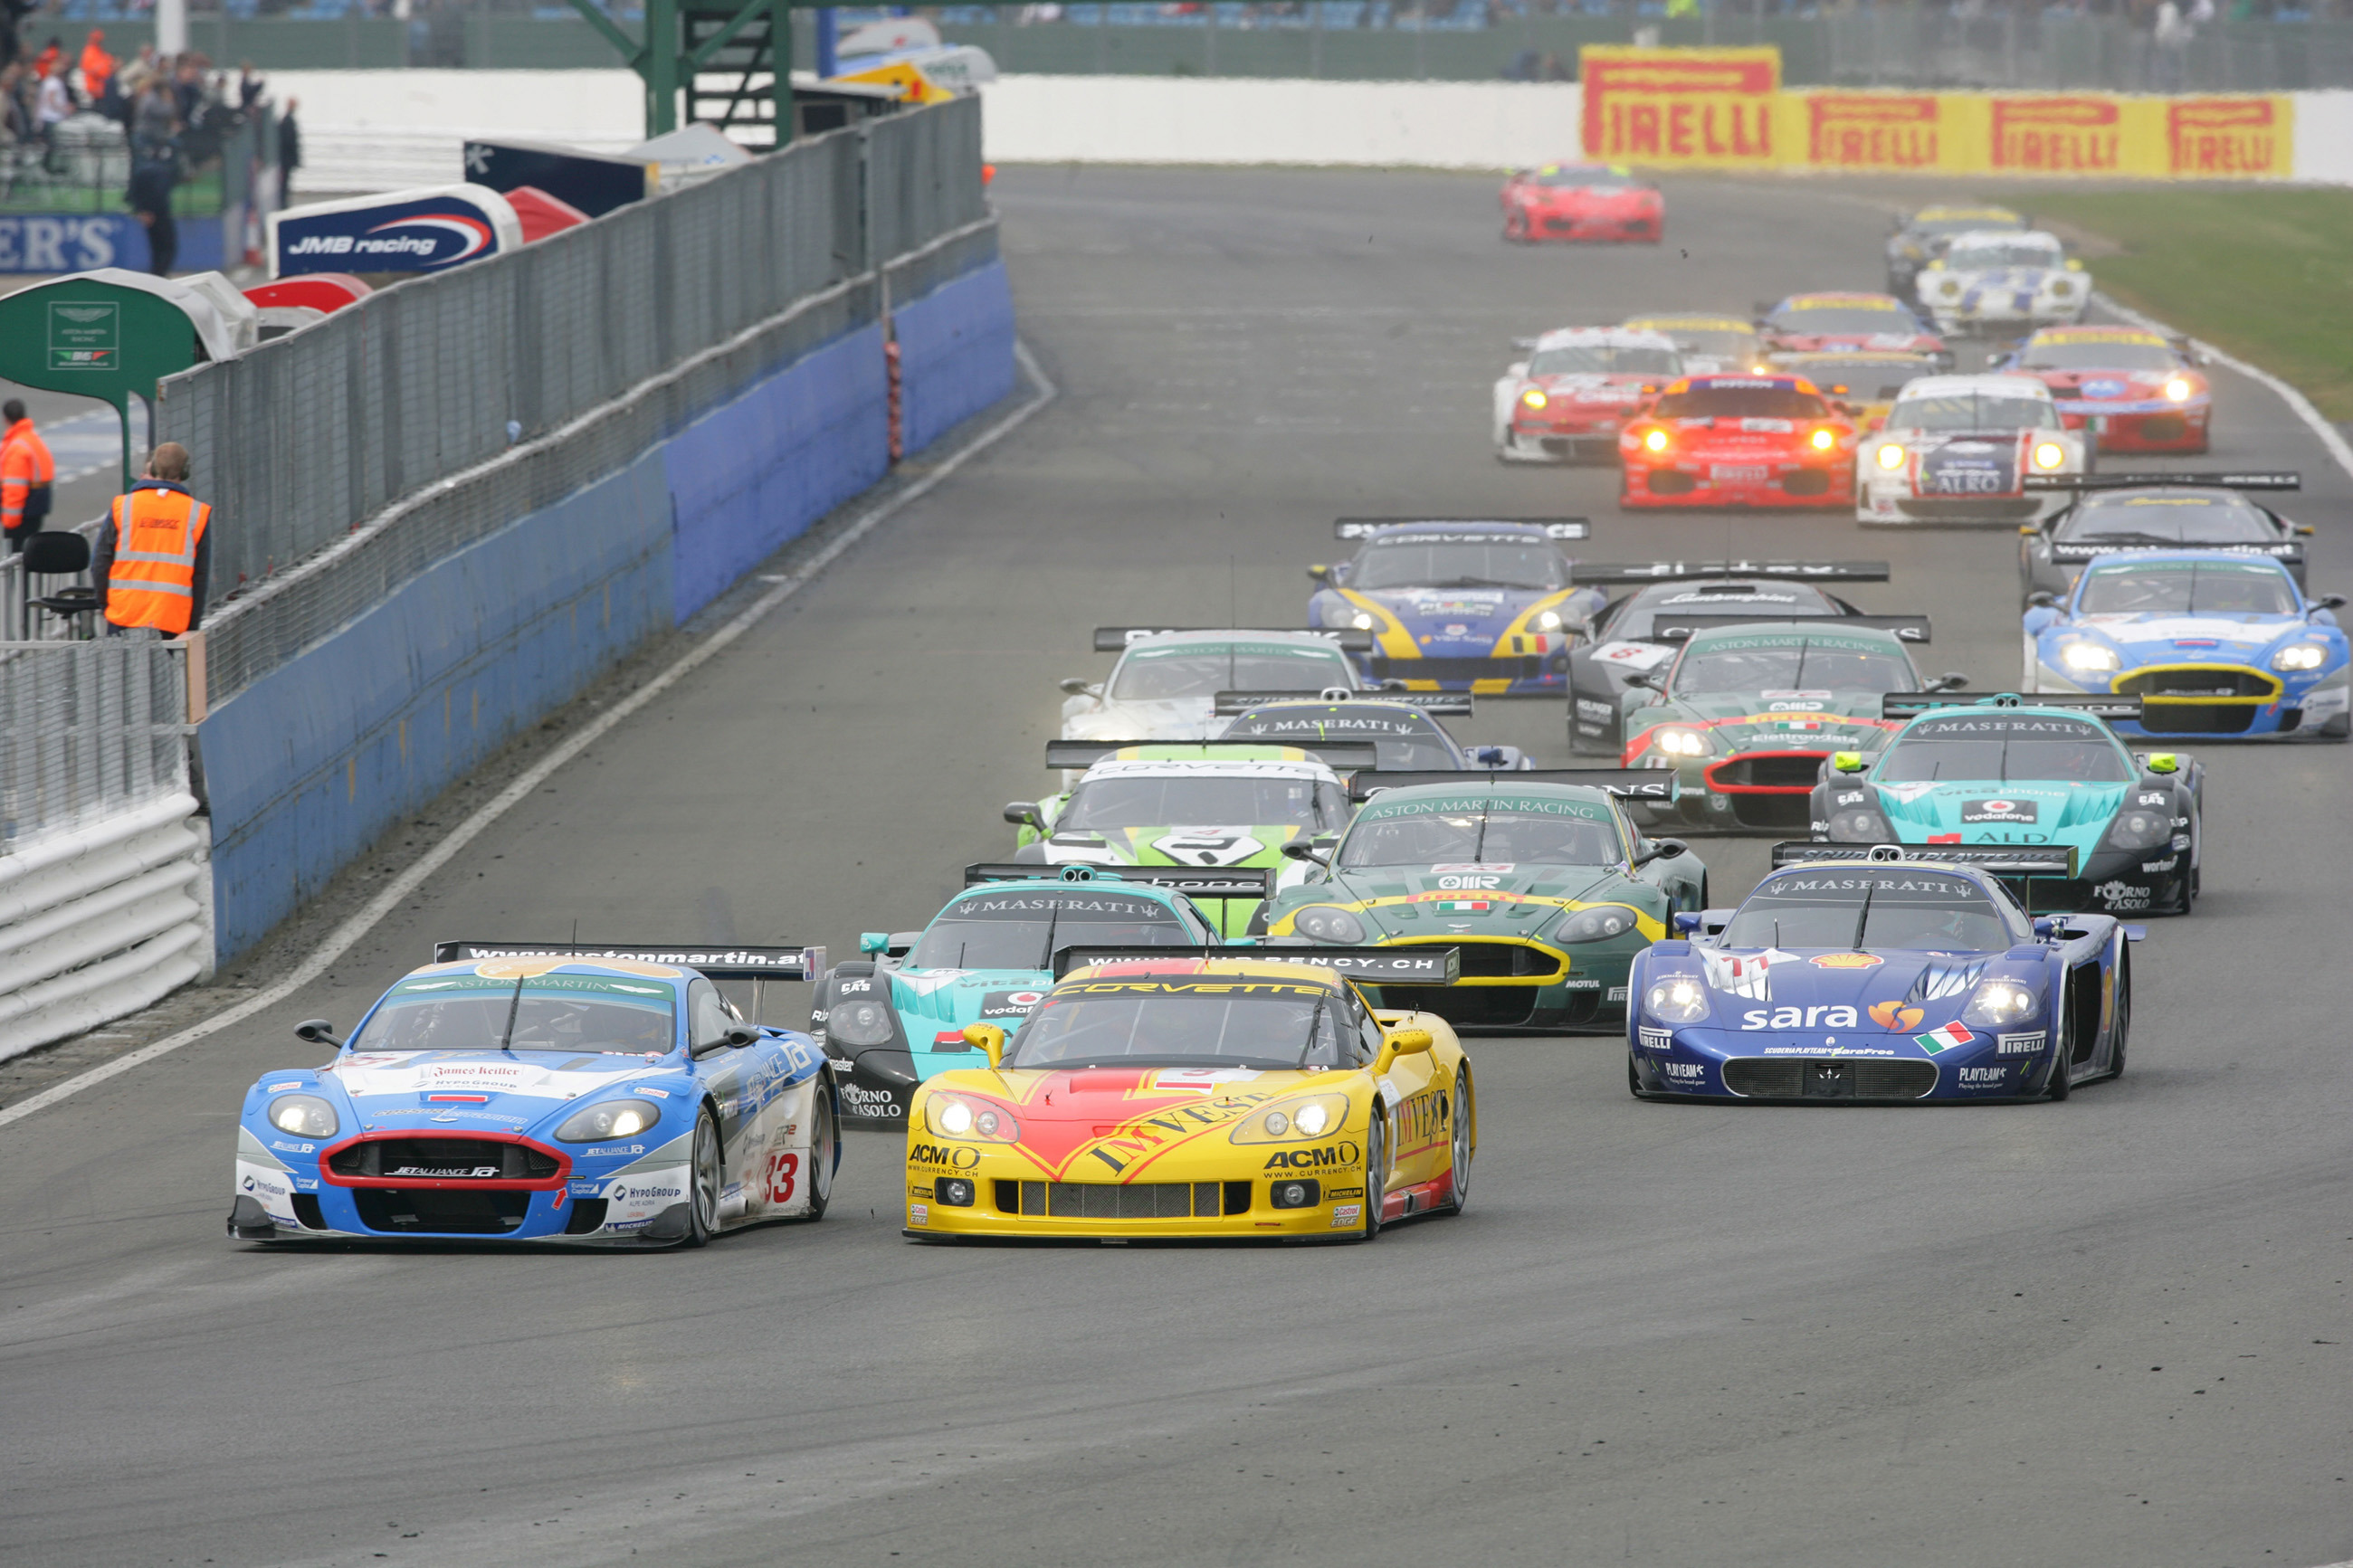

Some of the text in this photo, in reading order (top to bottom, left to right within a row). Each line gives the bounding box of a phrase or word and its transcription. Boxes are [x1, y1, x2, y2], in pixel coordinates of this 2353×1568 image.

[1584, 60, 1774, 156] PIRELLI
[1807, 96, 1937, 165] PIRELLI
[1991, 99, 2120, 169] PIRELLI
[2167, 100, 2274, 171] PIRELLI
[288, 235, 437, 255] JMB racing
[1660, 593, 1796, 604] Lamborghini
[1707, 636, 1882, 653] ASTON MARTIN RACING
[1274, 719, 1390, 731] MASERATI
[1936, 722, 2073, 733] MASERATI
[1938, 787, 2066, 797] vitaphone
[1369, 799, 1594, 820] ASTON MARTIN RACING
[1964, 813, 2034, 822] vodafone
[1976, 832, 2048, 844] ALD
[1791, 880, 1949, 893] MASERATI
[2093, 880, 2151, 900] FORNO
[980, 899, 1136, 914] MASERATI
[469, 947, 805, 965] wwwstonmartin.at
[453, 974, 609, 993] ASTON MARTIN
[1053, 983, 1334, 997] CORVETTE
[1566, 980, 1600, 988] MOTUL
[1741, 1005, 1858, 1030] sara
[1638, 1025, 1673, 1050] PIRELLI
[1996, 1030, 2046, 1054] PIRELLI
[434, 1067, 519, 1077] James Keiller
[1959, 1068, 2000, 1081] PLAYTEAM
[840, 1083, 892, 1105] FORNO
[1086, 1092, 1275, 1177] IMVEST
[586, 1146, 629, 1155] JETALLIANCE
[909, 1144, 950, 1164] ACM
[1263, 1146, 1337, 1169] ACM
[395, 1166, 468, 1174] JETALLIANCE
[908, 1164, 978, 1177] WWW.CURRENCY.CH
[1263, 1165, 1362, 1178] WWW.CURRENCY.CH
[764, 1153, 799, 1204] 33
[630, 1186, 681, 1198] HYPOGROUP
[1339, 1206, 1358, 1215] Castrol
[910, 1216, 928, 1225] EDGE
[1331, 1217, 1358, 1228] EDGE
